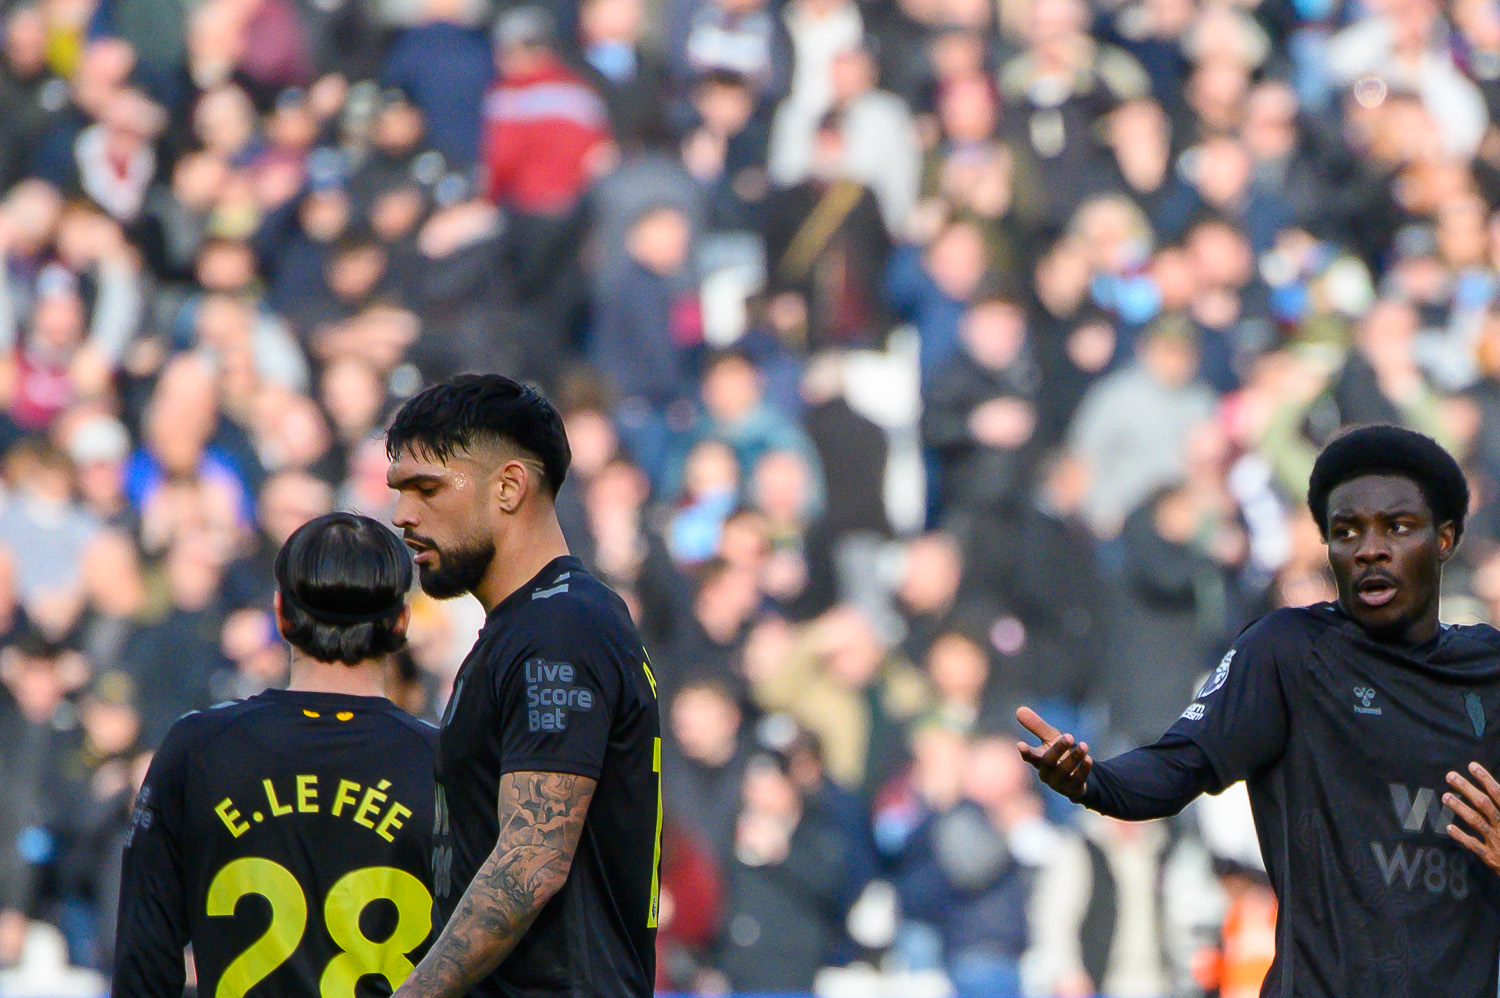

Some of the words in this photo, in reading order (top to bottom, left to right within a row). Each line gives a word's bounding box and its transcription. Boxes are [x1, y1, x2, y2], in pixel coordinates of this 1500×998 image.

[525, 660, 574, 683] Live
[527, 684, 593, 709] Score
[528, 708, 566, 732] Bet
[330, 779, 412, 843] FÉE
[1371, 841, 1470, 900] W88
